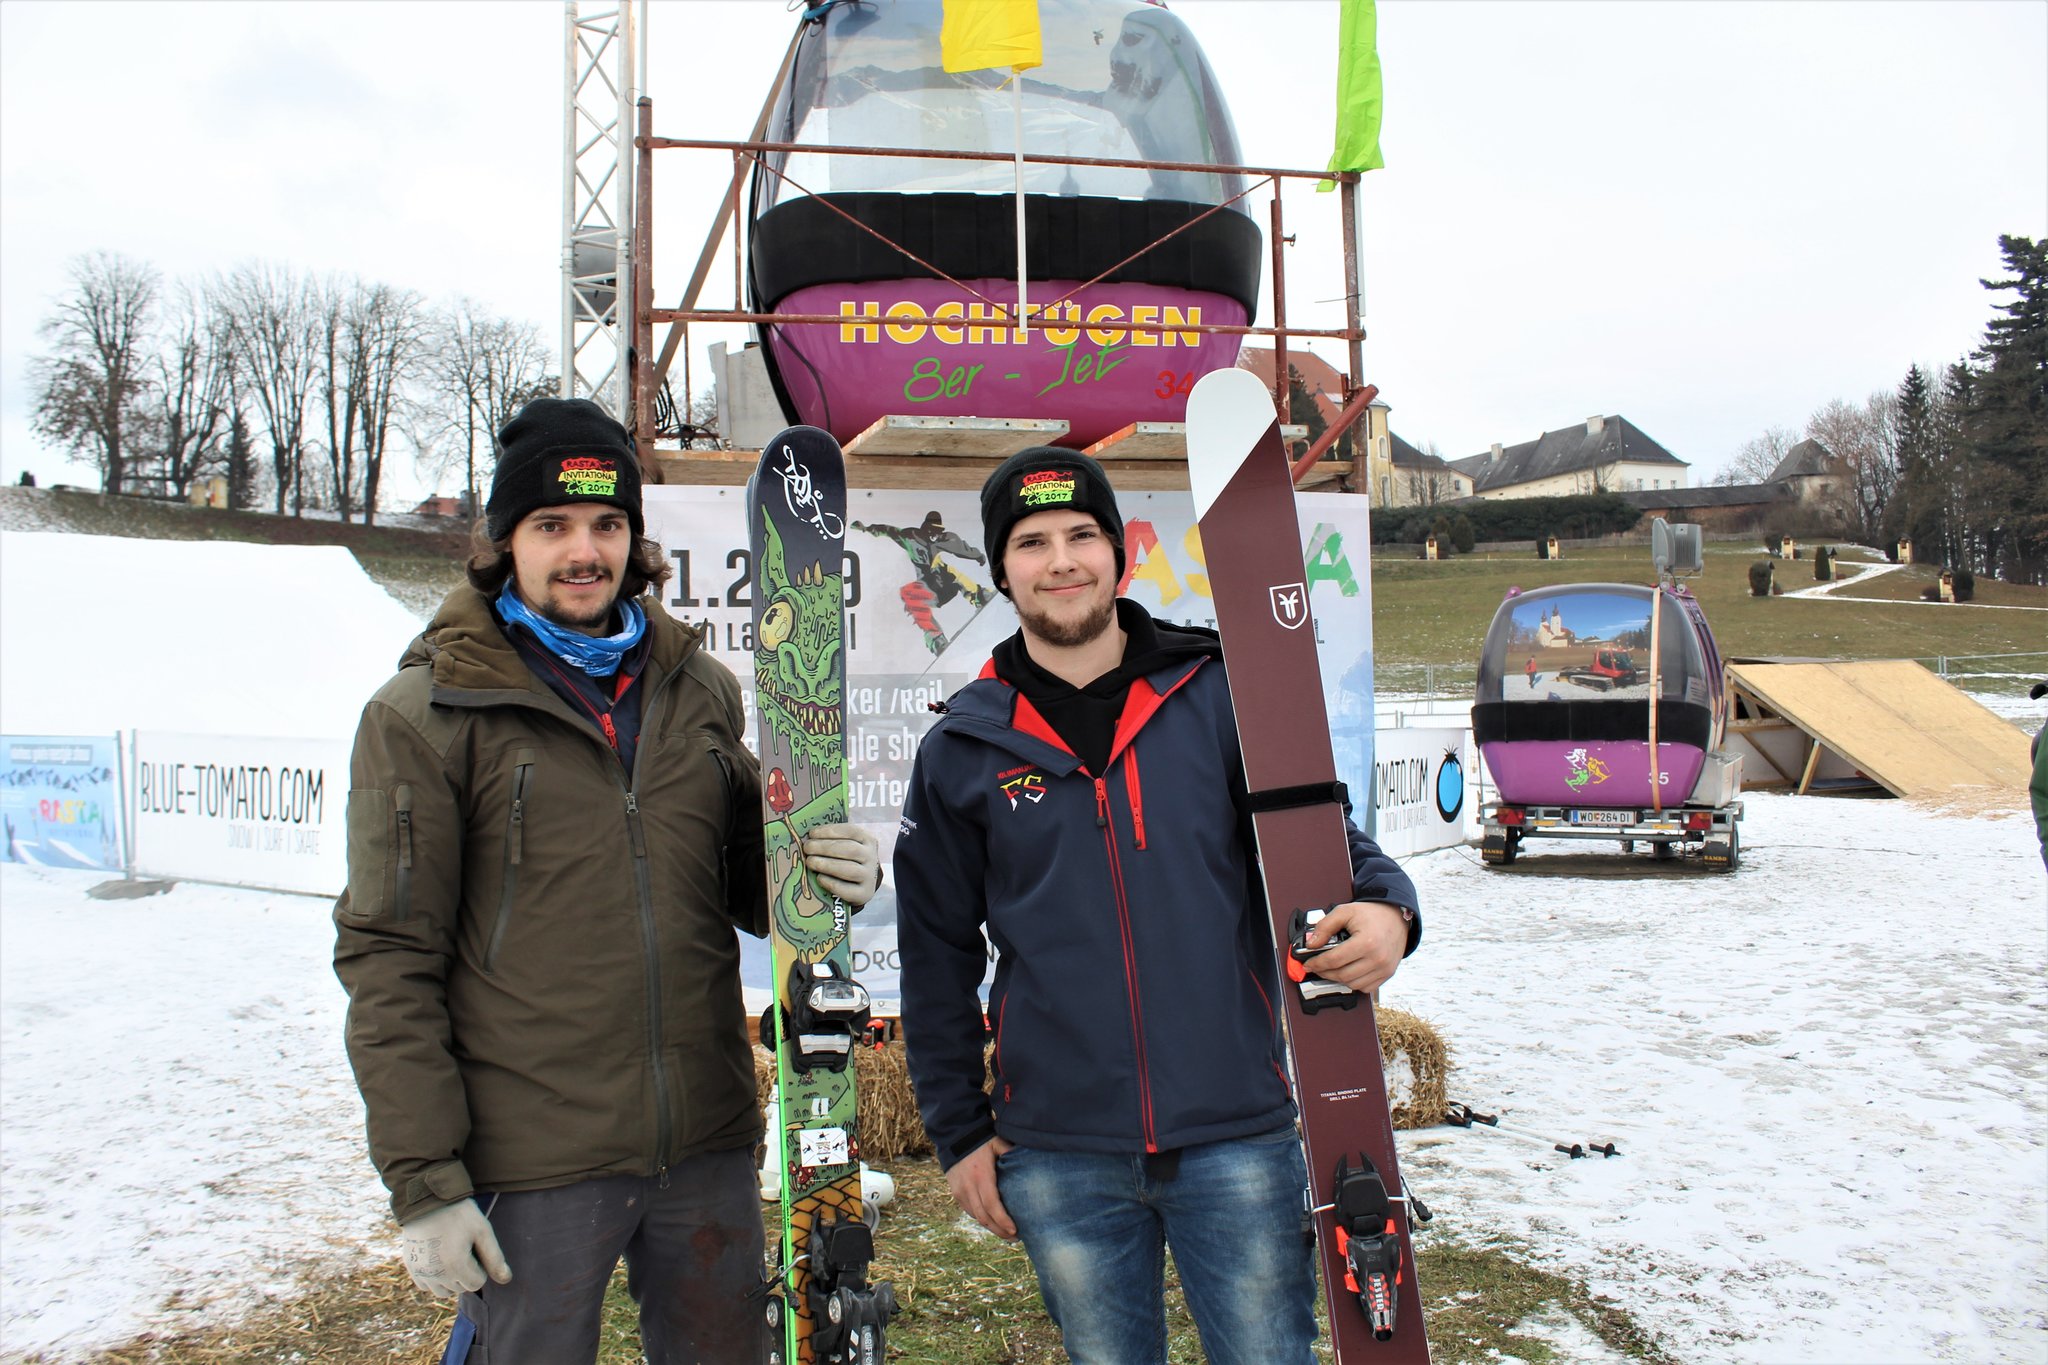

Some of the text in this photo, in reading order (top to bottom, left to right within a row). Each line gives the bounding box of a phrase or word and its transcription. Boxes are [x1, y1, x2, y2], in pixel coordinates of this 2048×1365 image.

[903, 357, 984, 402] 8er
[1035, 339, 1142, 398] Jet
[1155, 370, 1194, 399] 34
[566, 460, 597, 468] RASTA
[564, 471, 615, 481] INVITATIONAL
[1027, 472, 1053, 482] RASTA
[587, 484, 611, 493] 2017
[1024, 482, 1073, 494] INVITATIONAL
[1045, 493, 1068, 501] 2017
[847, 681, 882, 714] ker
[141, 761, 324, 825] BLUE-TOMATO.COM
[1600, 812, 1618, 822] 264
[852, 949, 902, 973] DRO
[1373, 1278, 1385, 1311] JESTER
